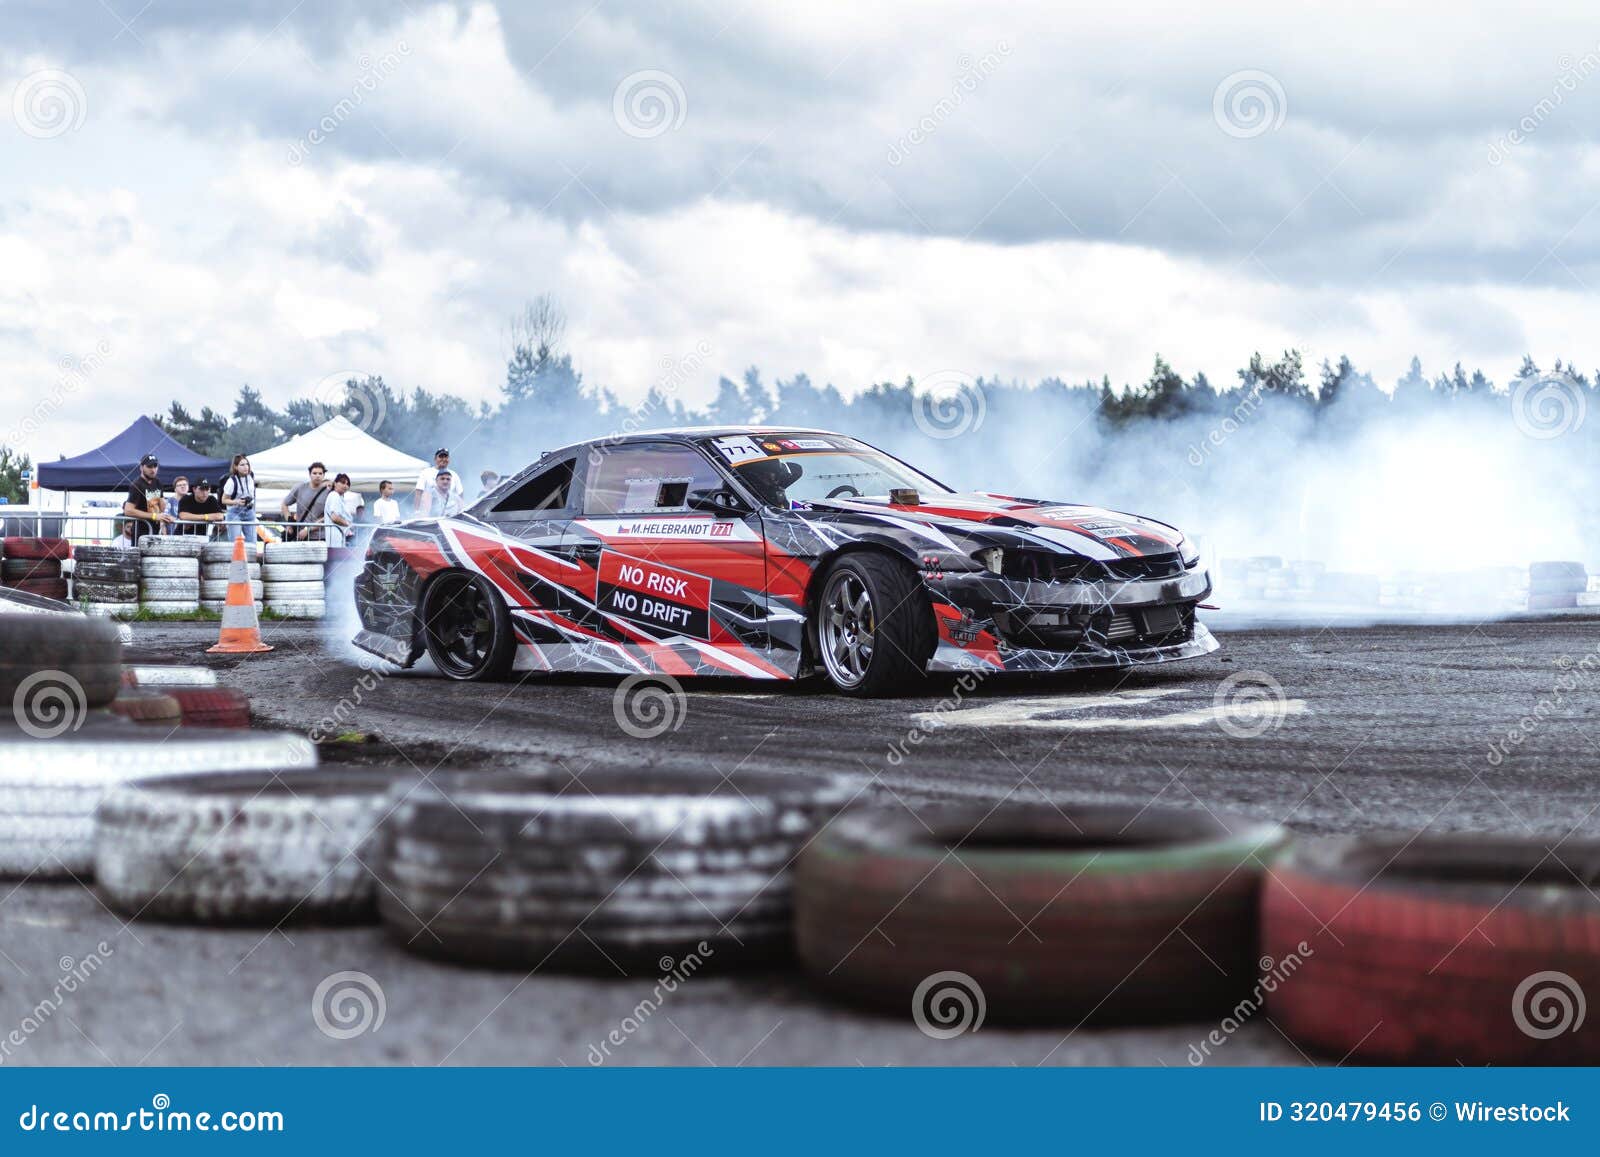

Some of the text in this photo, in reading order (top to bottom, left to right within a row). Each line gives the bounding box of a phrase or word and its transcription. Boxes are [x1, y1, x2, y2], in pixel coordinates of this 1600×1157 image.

[722, 445, 759, 455] 771
[631, 523, 732, 535] M.HELEBRANDT 771
[619, 564, 688, 598] NO RISK
[613, 591, 691, 626] NO DRIFT
